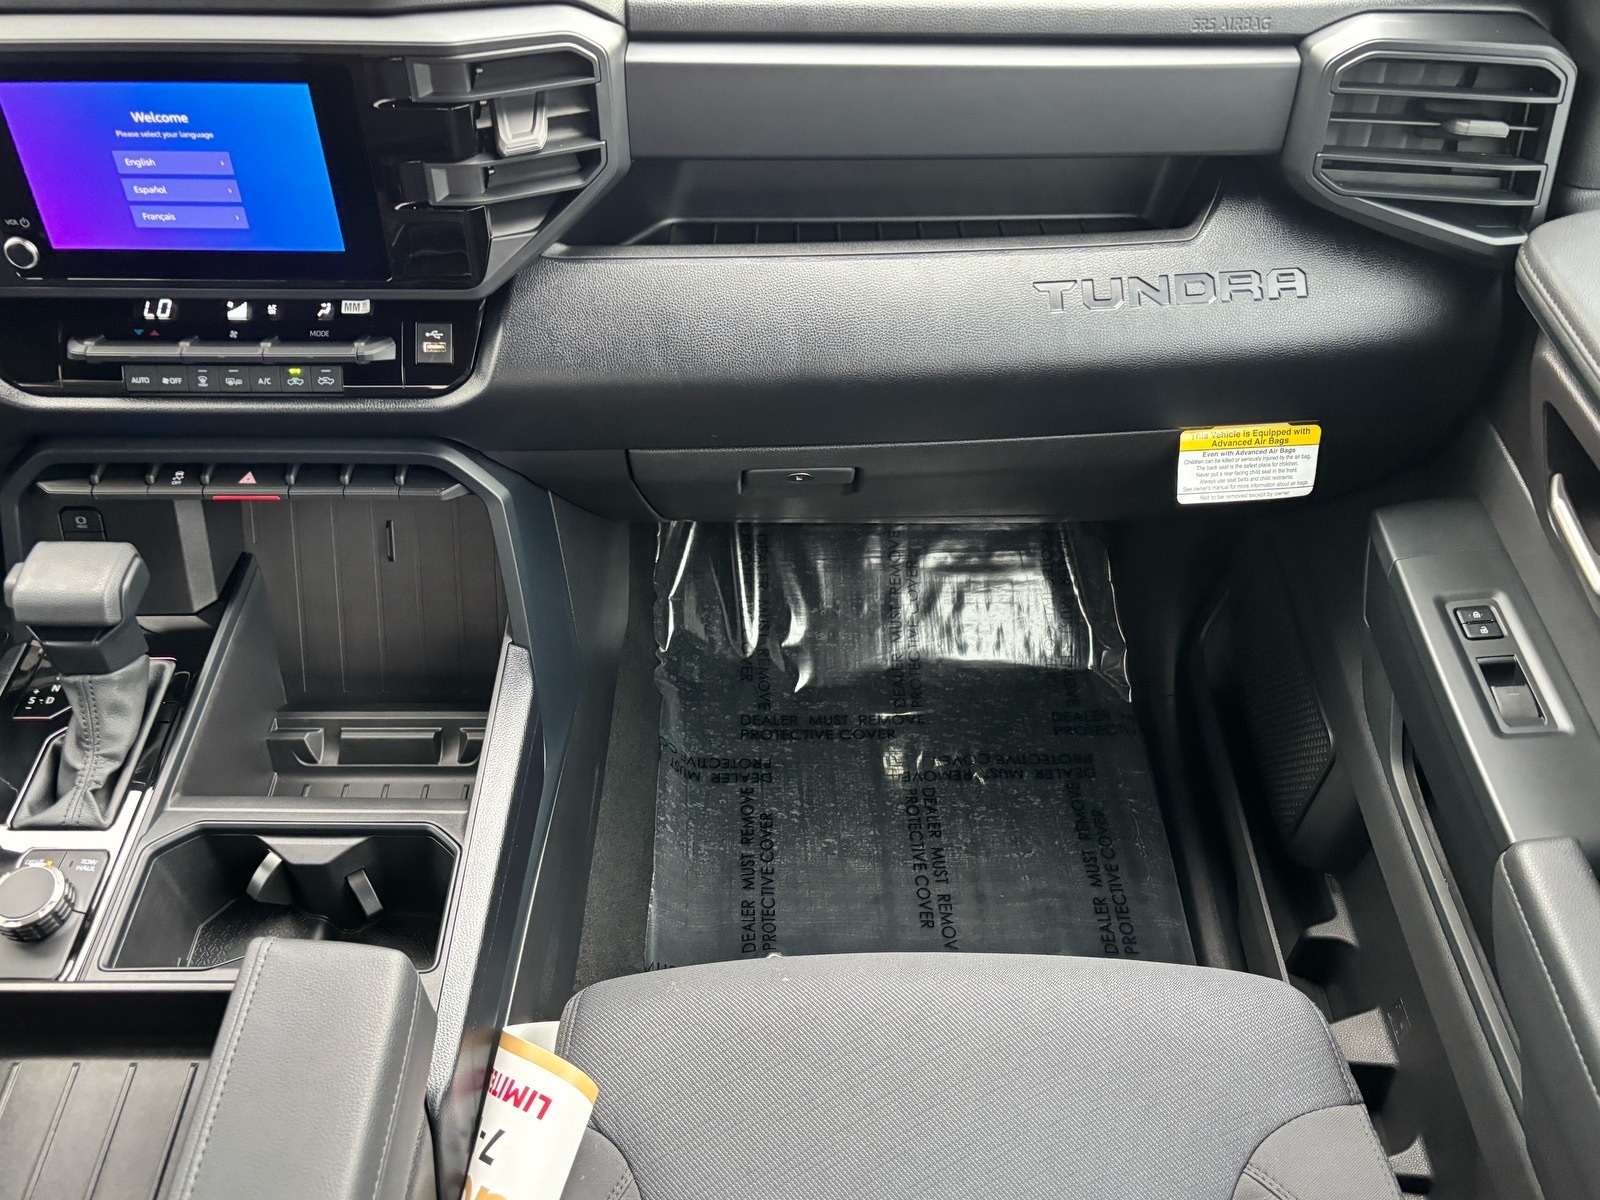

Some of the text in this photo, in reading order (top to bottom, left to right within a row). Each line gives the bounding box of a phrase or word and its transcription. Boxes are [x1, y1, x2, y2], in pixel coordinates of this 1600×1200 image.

[1191, 16, 1272, 32] SRS AIRBAG
[130, 111, 188, 124] Welcome
[116, 130, 214, 140] Please select your language
[124, 158, 156, 168] English
[133, 185, 168, 196] Español
[142, 212, 176, 223] Français
[1033, 267, 1308, 313] TUNDRA
[1212, 439, 1252, 447] Advanced
[1253, 428, 1291, 439] Equipped
[888, 530, 906, 708] DEALER MUST REMOVE
[905, 560, 922, 708] PROTECTIVE COVER
[758, 649, 770, 710] REMOVE
[28, 696, 55, 704] S D
[740, 714, 926, 726] DEALER MUST REMOVE
[740, 729, 896, 740] PROTECTIVE COVER
[681, 750, 772, 769] PROTECTIVE
[931, 753, 990, 766] COVE
[670, 757, 772, 783] DEALER MUST
[902, 768, 1096, 783] DEALER MUST REMOVE
[923, 787, 942, 838] DEALER
[905, 788, 934, 929] PROTECTIVE COVER
[931, 847, 949, 885] MUST
[1066, 782, 1119, 954] DEALER MUST REMOVE
[740, 786, 756, 953] DEALER MUST REMOVE
[760, 812, 777, 950] PROTECTIVE COVER
[1091, 808, 1140, 955] PROTECTIVE COVER
[489, 1068, 552, 1120] LIMITE
